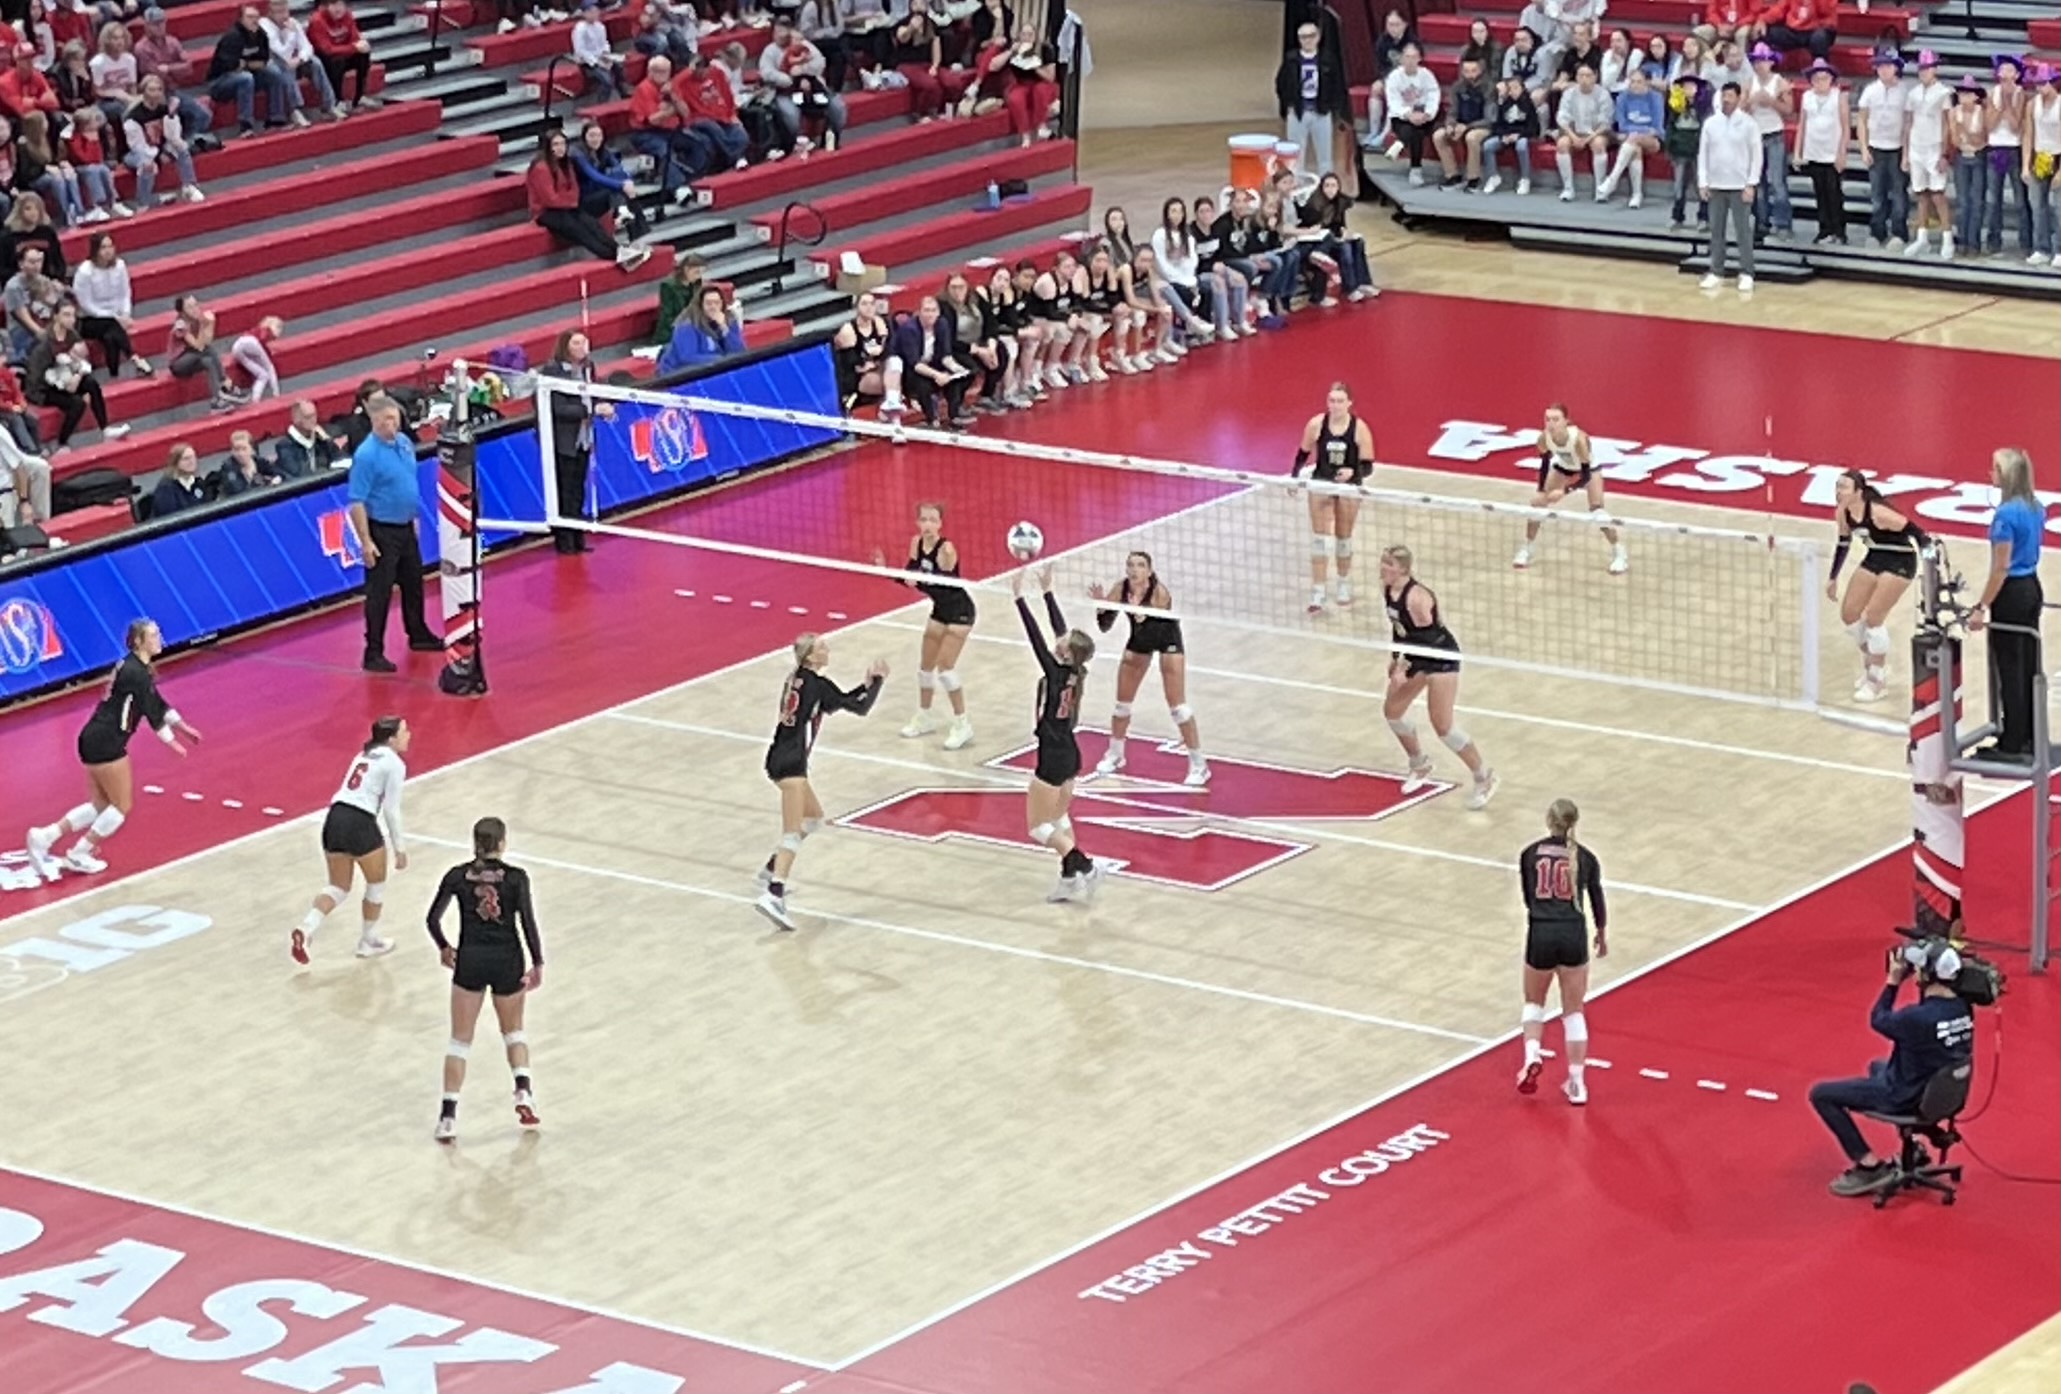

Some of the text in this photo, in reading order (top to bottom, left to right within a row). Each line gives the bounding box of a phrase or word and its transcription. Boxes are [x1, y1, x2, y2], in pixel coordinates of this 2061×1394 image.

[347, 762, 369, 791] 6
[1077, 1123, 1450, 1302] TERRY PETTIT COURT
